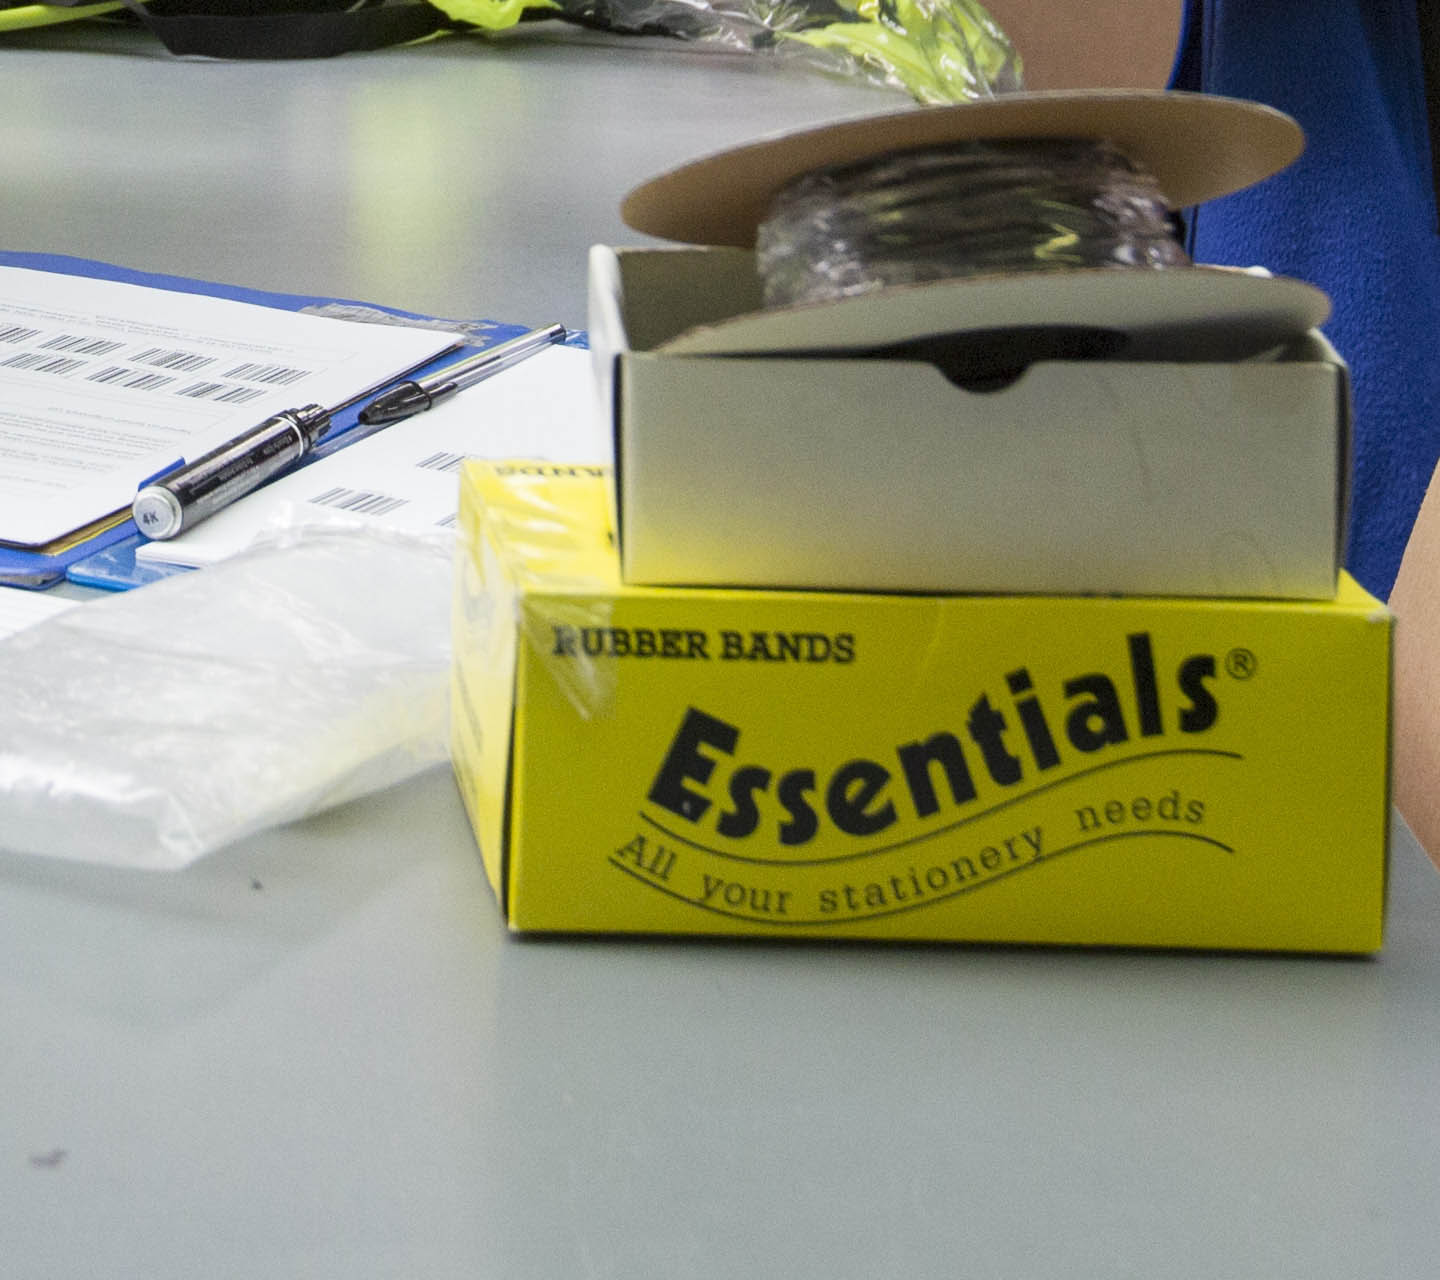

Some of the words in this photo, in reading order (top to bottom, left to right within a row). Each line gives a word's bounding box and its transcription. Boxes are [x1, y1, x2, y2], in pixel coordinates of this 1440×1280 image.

[554, 624, 709, 662] RUBBER
[720, 629, 856, 665] BANDS
[616, 834, 675, 883] All
[699, 868, 791, 916] your
[818, 825, 1046, 915] stationery
[1075, 789, 1206, 833] needs
